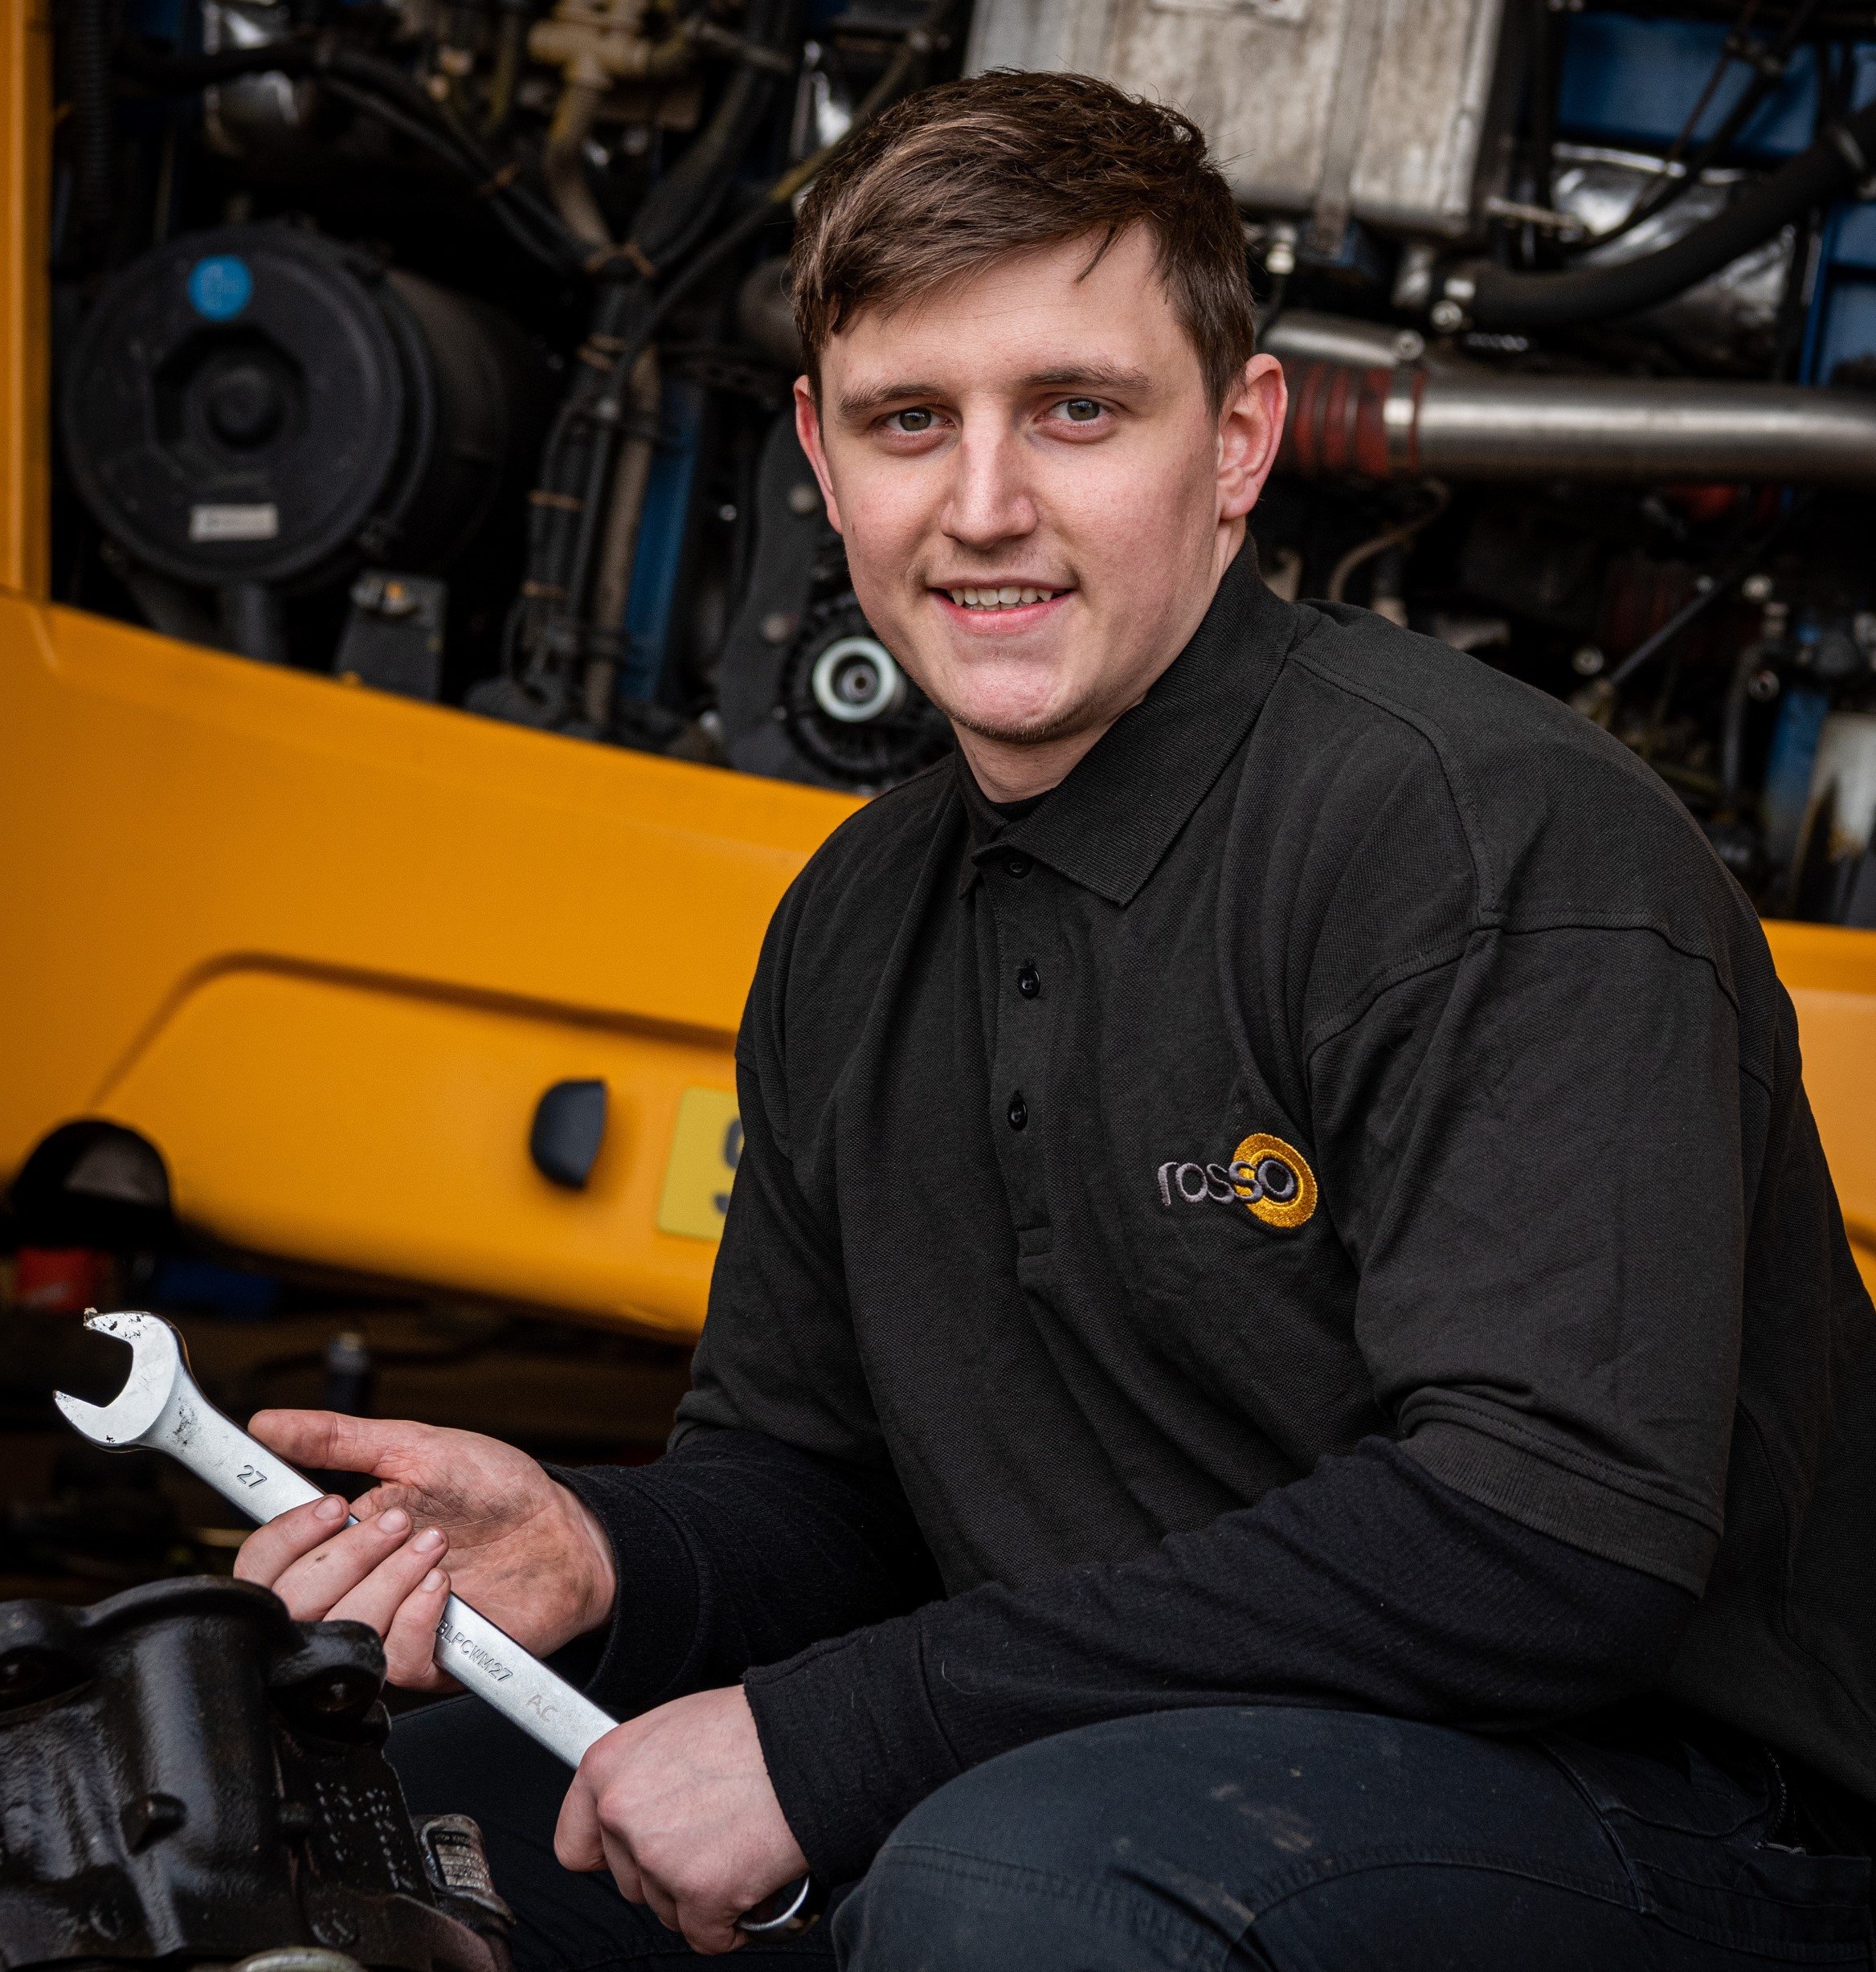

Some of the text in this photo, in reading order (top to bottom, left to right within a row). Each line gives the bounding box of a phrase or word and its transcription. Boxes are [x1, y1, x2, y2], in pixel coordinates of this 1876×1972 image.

[1158, 1160, 1295, 1206] rosso
[236, 1464, 268, 1488] 27
[435, 1619, 513, 1683] BLPCWM27
